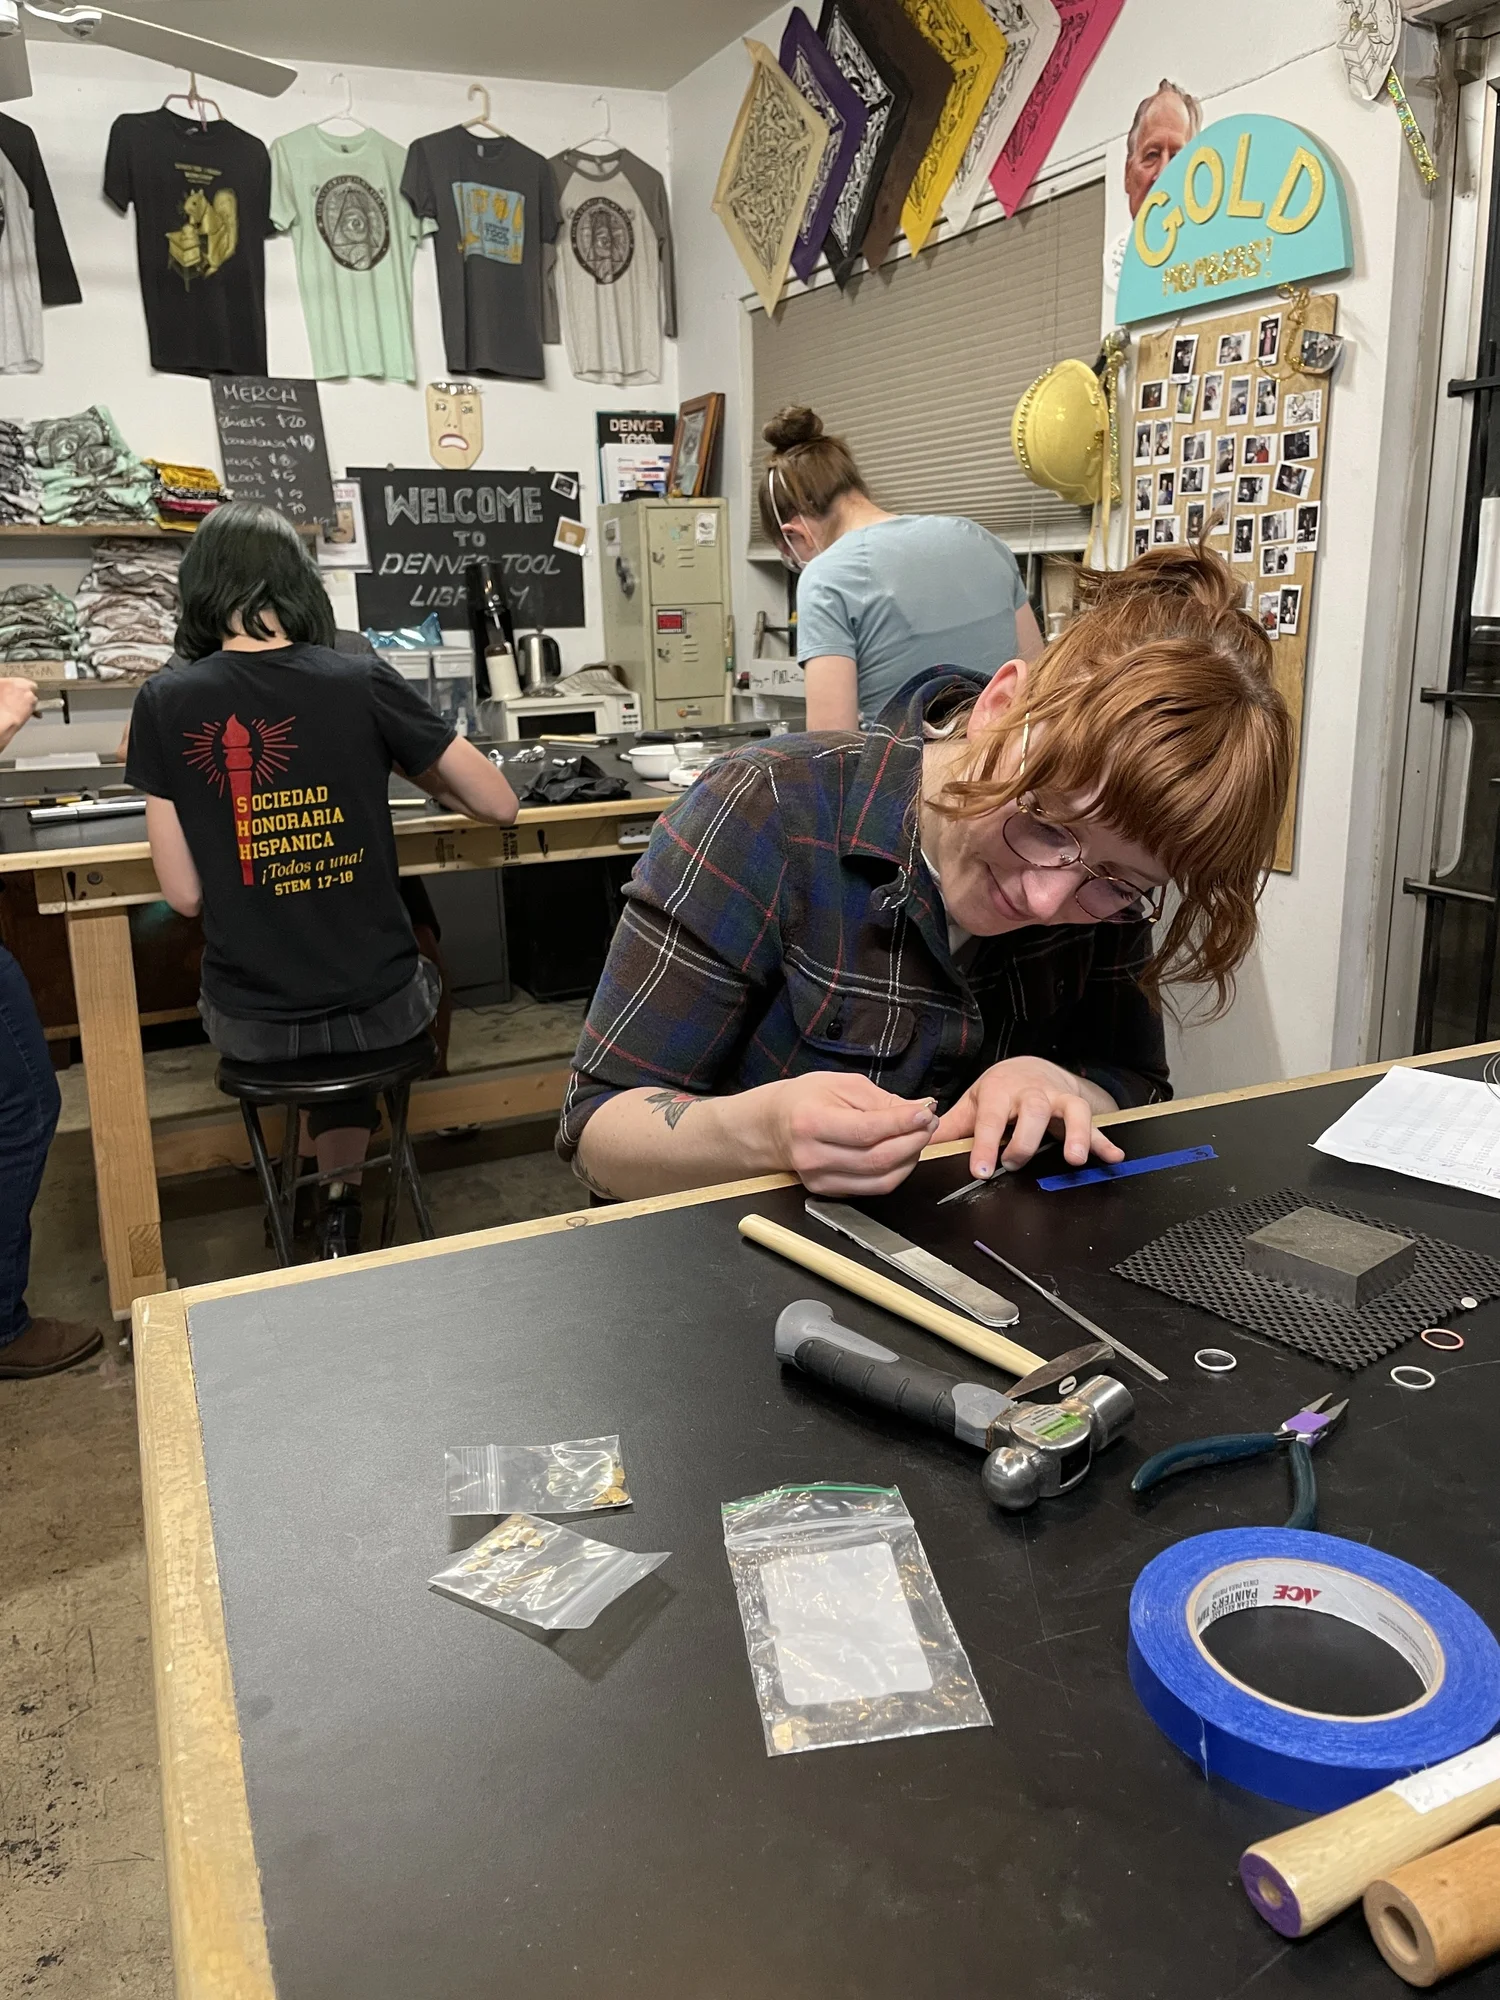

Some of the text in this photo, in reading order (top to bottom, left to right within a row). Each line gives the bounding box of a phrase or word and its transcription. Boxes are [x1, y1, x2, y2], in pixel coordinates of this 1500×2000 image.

[1134, 132, 1325, 267] GOLD
[223, 384, 298, 403] MERCH
[609, 418, 665, 432] DENVER
[384, 485, 543, 526] WELCOME
[452, 530, 487, 547] TO
[501, 553, 561, 575] TOOL
[236, 786, 328, 813] SOCIEDAD
[237, 807, 345, 837] HONORARIA
[239, 830, 335, 860] HISPANICA
[262, 847, 364, 885] ¡Todos a una!
[274, 870, 354, 896] STEM 17-18
[1211, 1588, 1258, 1611] PAINTER'S
[1237, 1598, 1258, 1610] CLEAN
[1273, 1585, 1322, 1605] ACE
